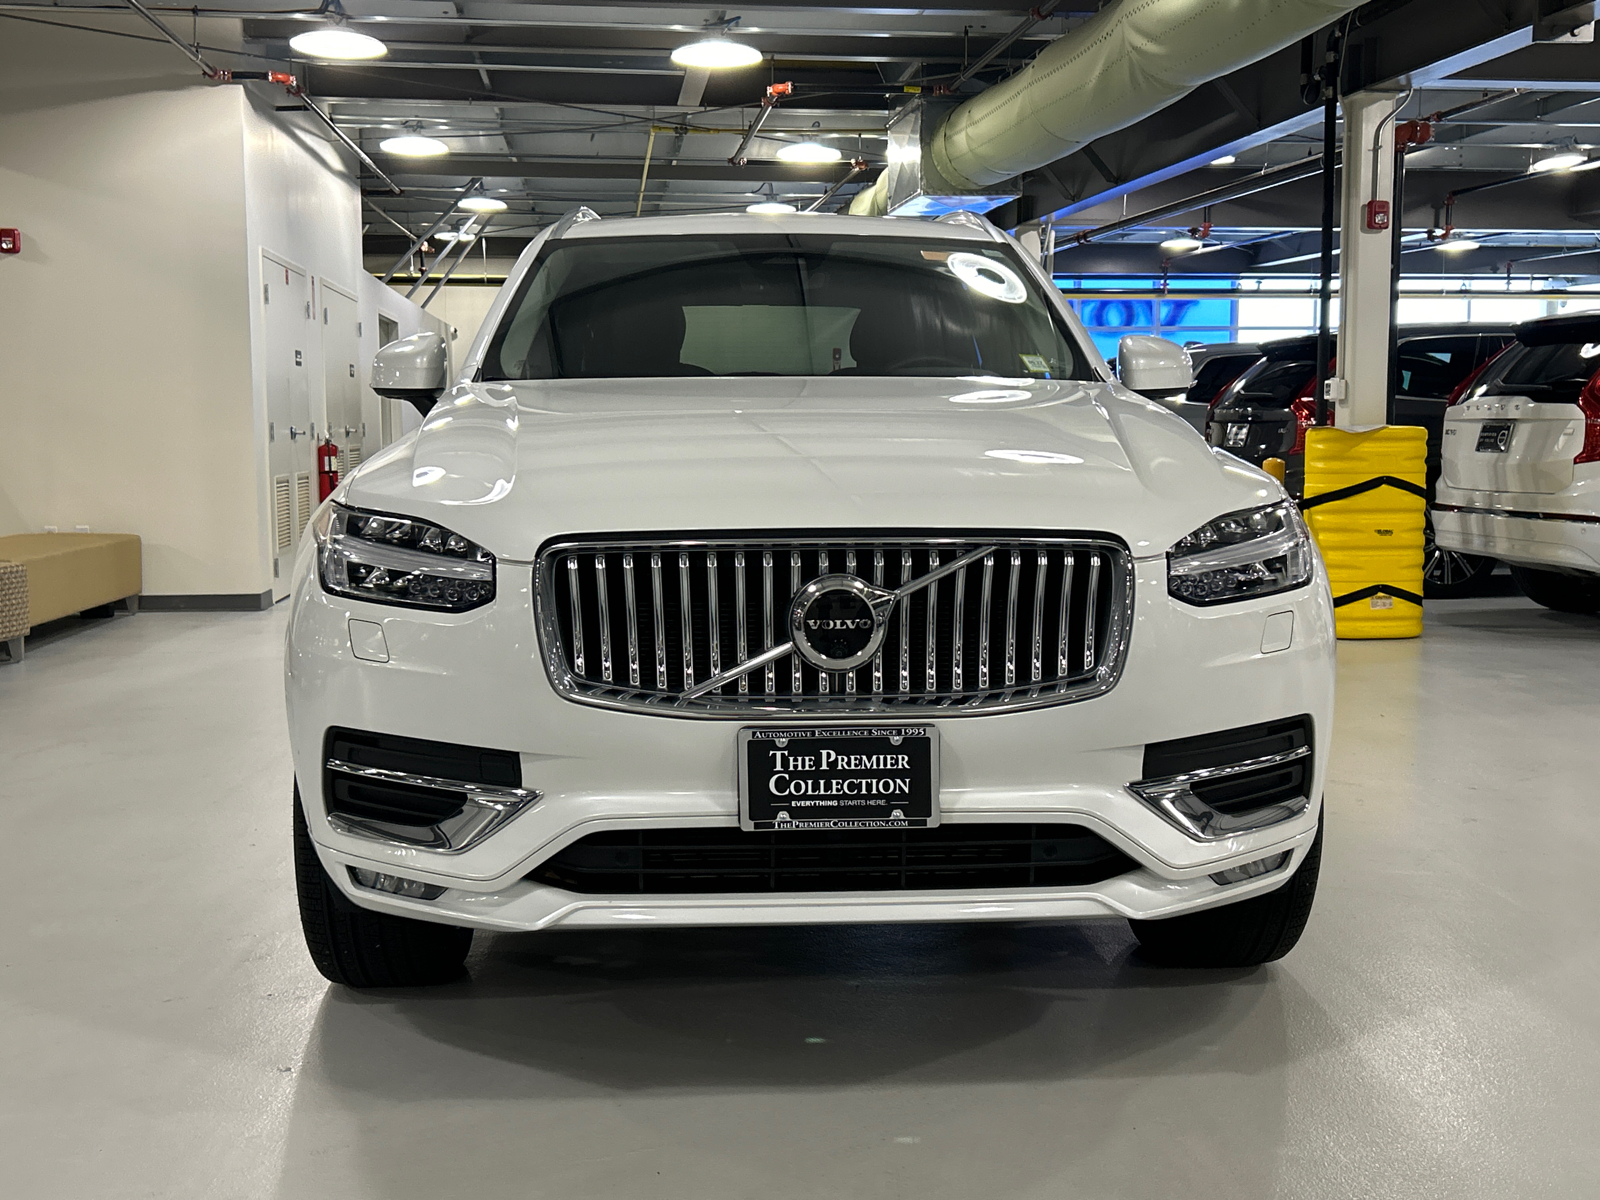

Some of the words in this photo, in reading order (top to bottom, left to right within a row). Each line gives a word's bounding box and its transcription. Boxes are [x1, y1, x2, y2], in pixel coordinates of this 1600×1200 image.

[807, 619, 872, 630] VOLVO
[754, 731, 812, 739] AUTOMOTIVE
[815, 729, 869, 737] EXCELLENCE
[871, 728, 898, 736] SINCE
[900, 728, 925, 736] 1995
[769, 750, 815, 771] THE
[819, 749, 910, 770] PREMIER
[769, 773, 910, 796] COLLECTION
